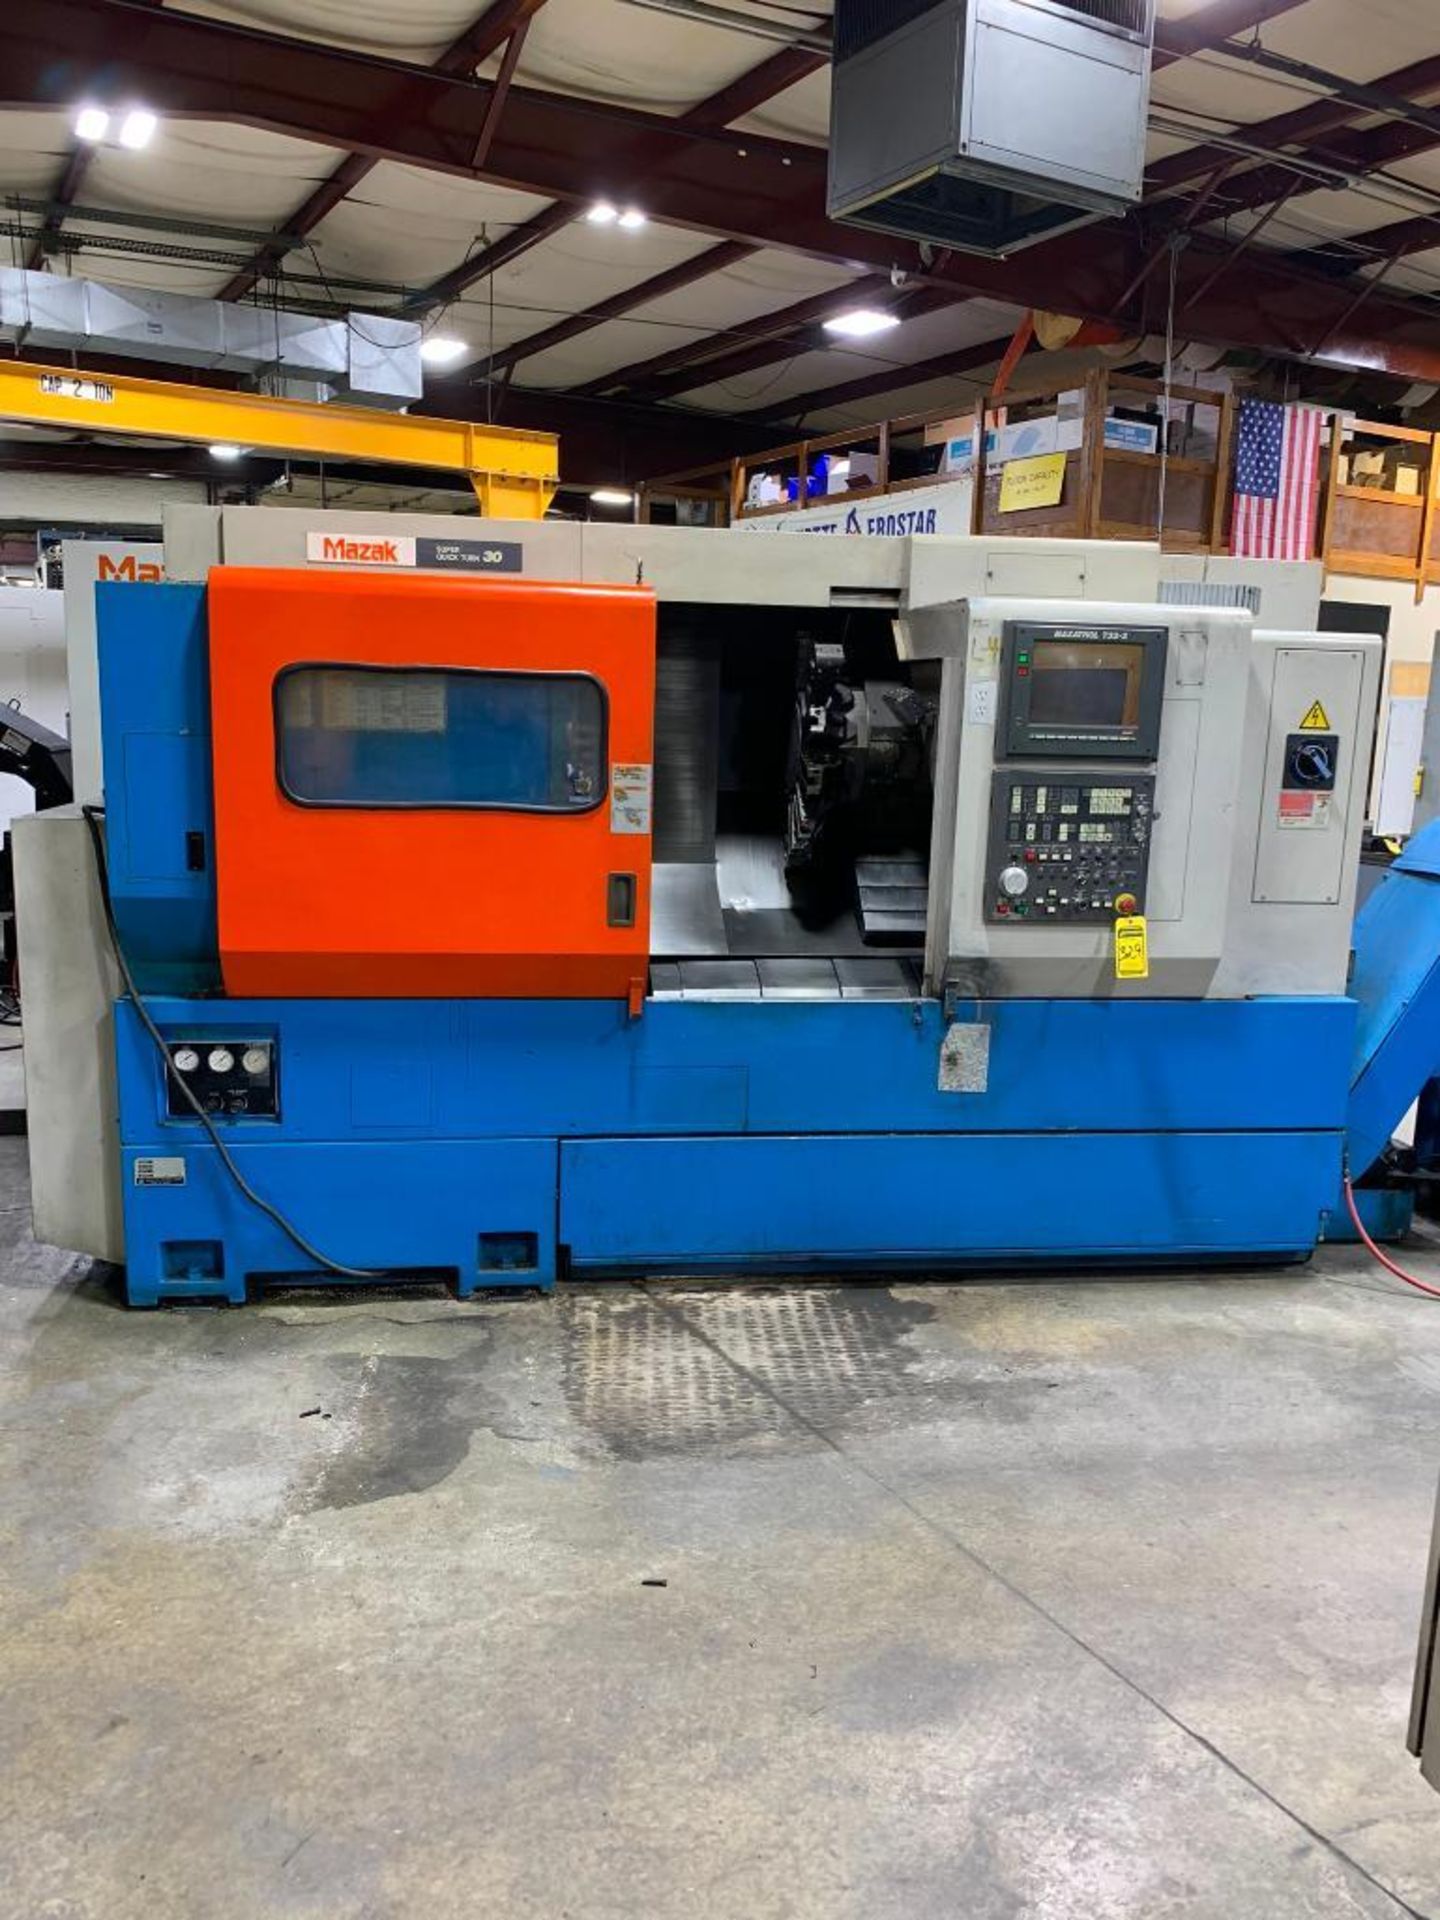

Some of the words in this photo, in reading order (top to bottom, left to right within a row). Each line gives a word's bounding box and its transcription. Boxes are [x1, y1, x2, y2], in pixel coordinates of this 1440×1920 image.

[72, 378, 83, 398] 2
[94, 382, 114, 401] TON
[323, 537, 398, 562] Mazak
[482, 550, 503, 563] 30
[98, 554, 165, 582] Ma
